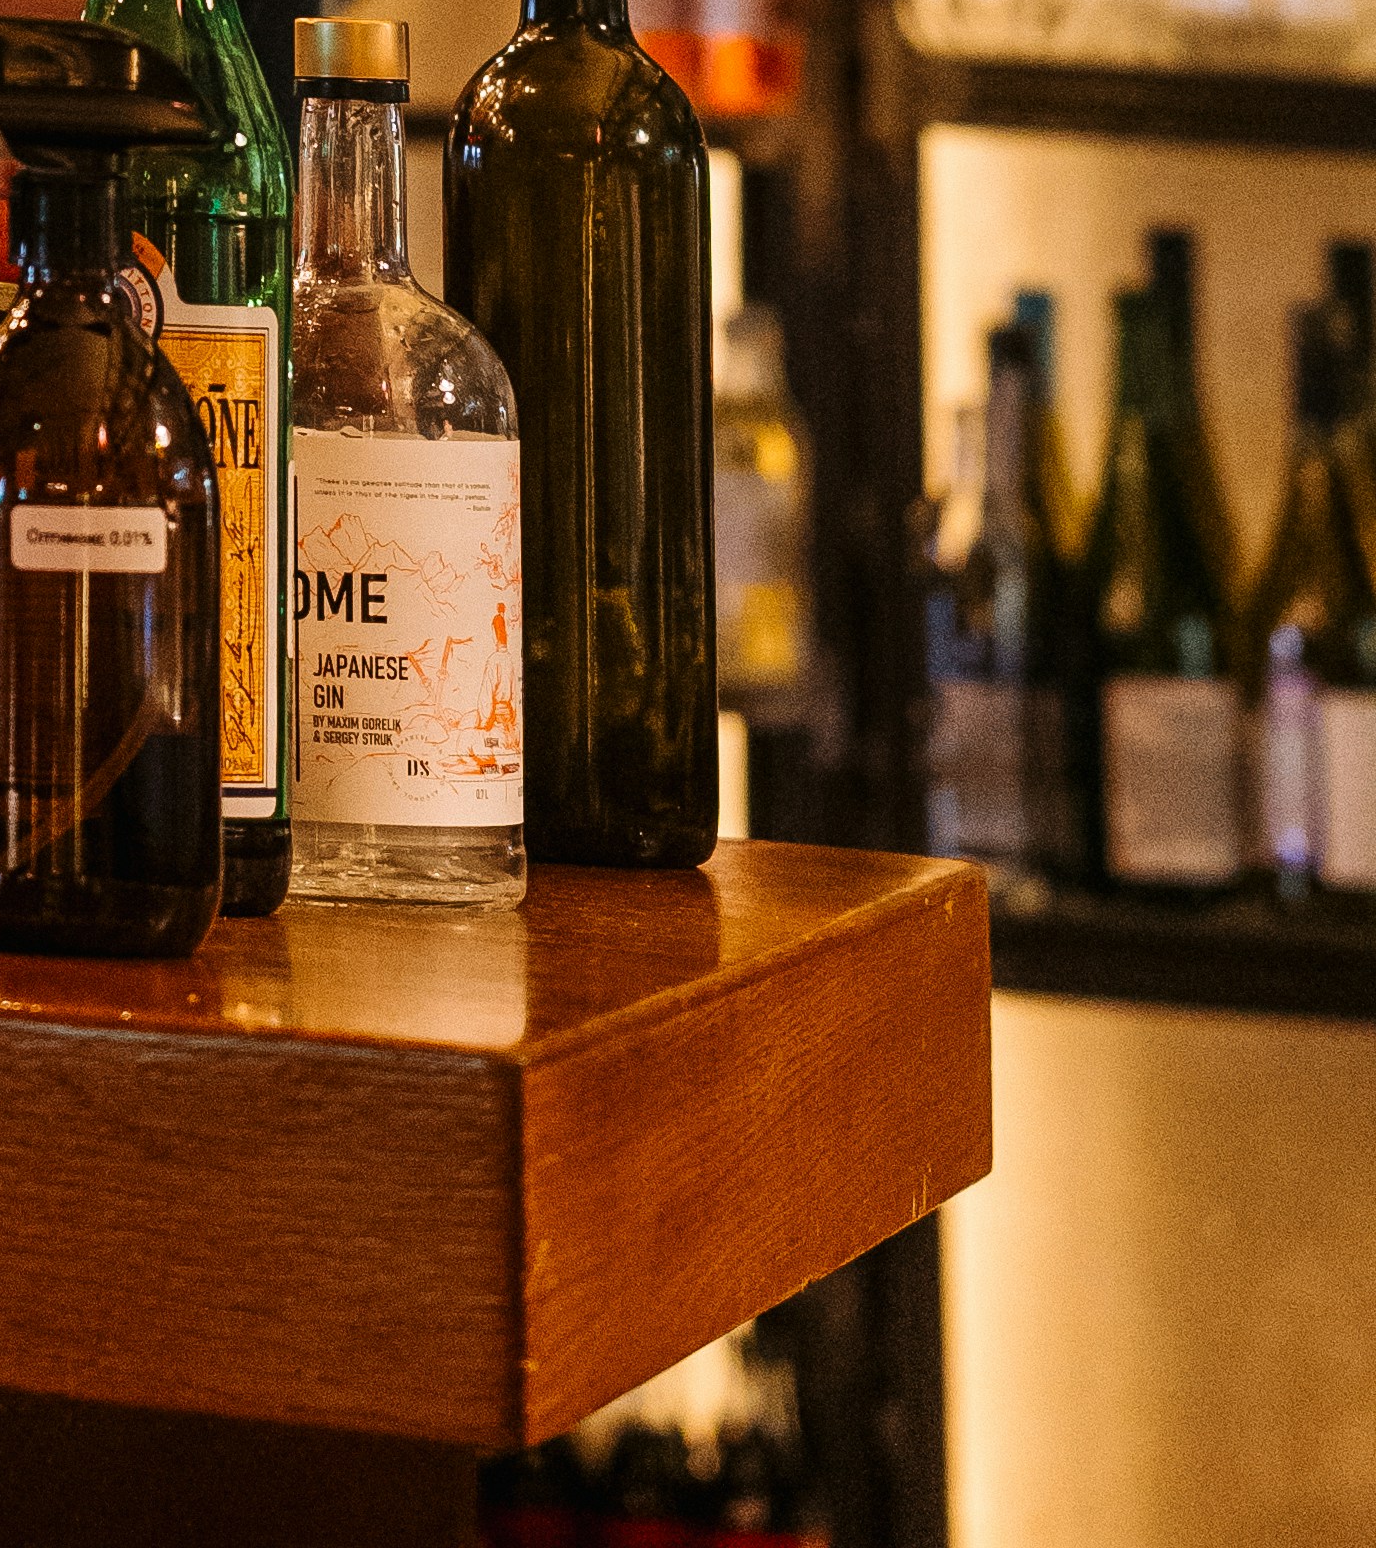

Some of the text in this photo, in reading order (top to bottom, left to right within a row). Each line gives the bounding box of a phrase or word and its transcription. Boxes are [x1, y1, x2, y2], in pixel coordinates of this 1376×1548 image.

[313, 653, 409, 681] JAPANESE
[313, 684, 344, 709] GIN
[313, 715, 402, 731] BY MAXIM GORELIK
[313, 730, 321, 744] &
[323, 731, 360, 745] SERGEY
